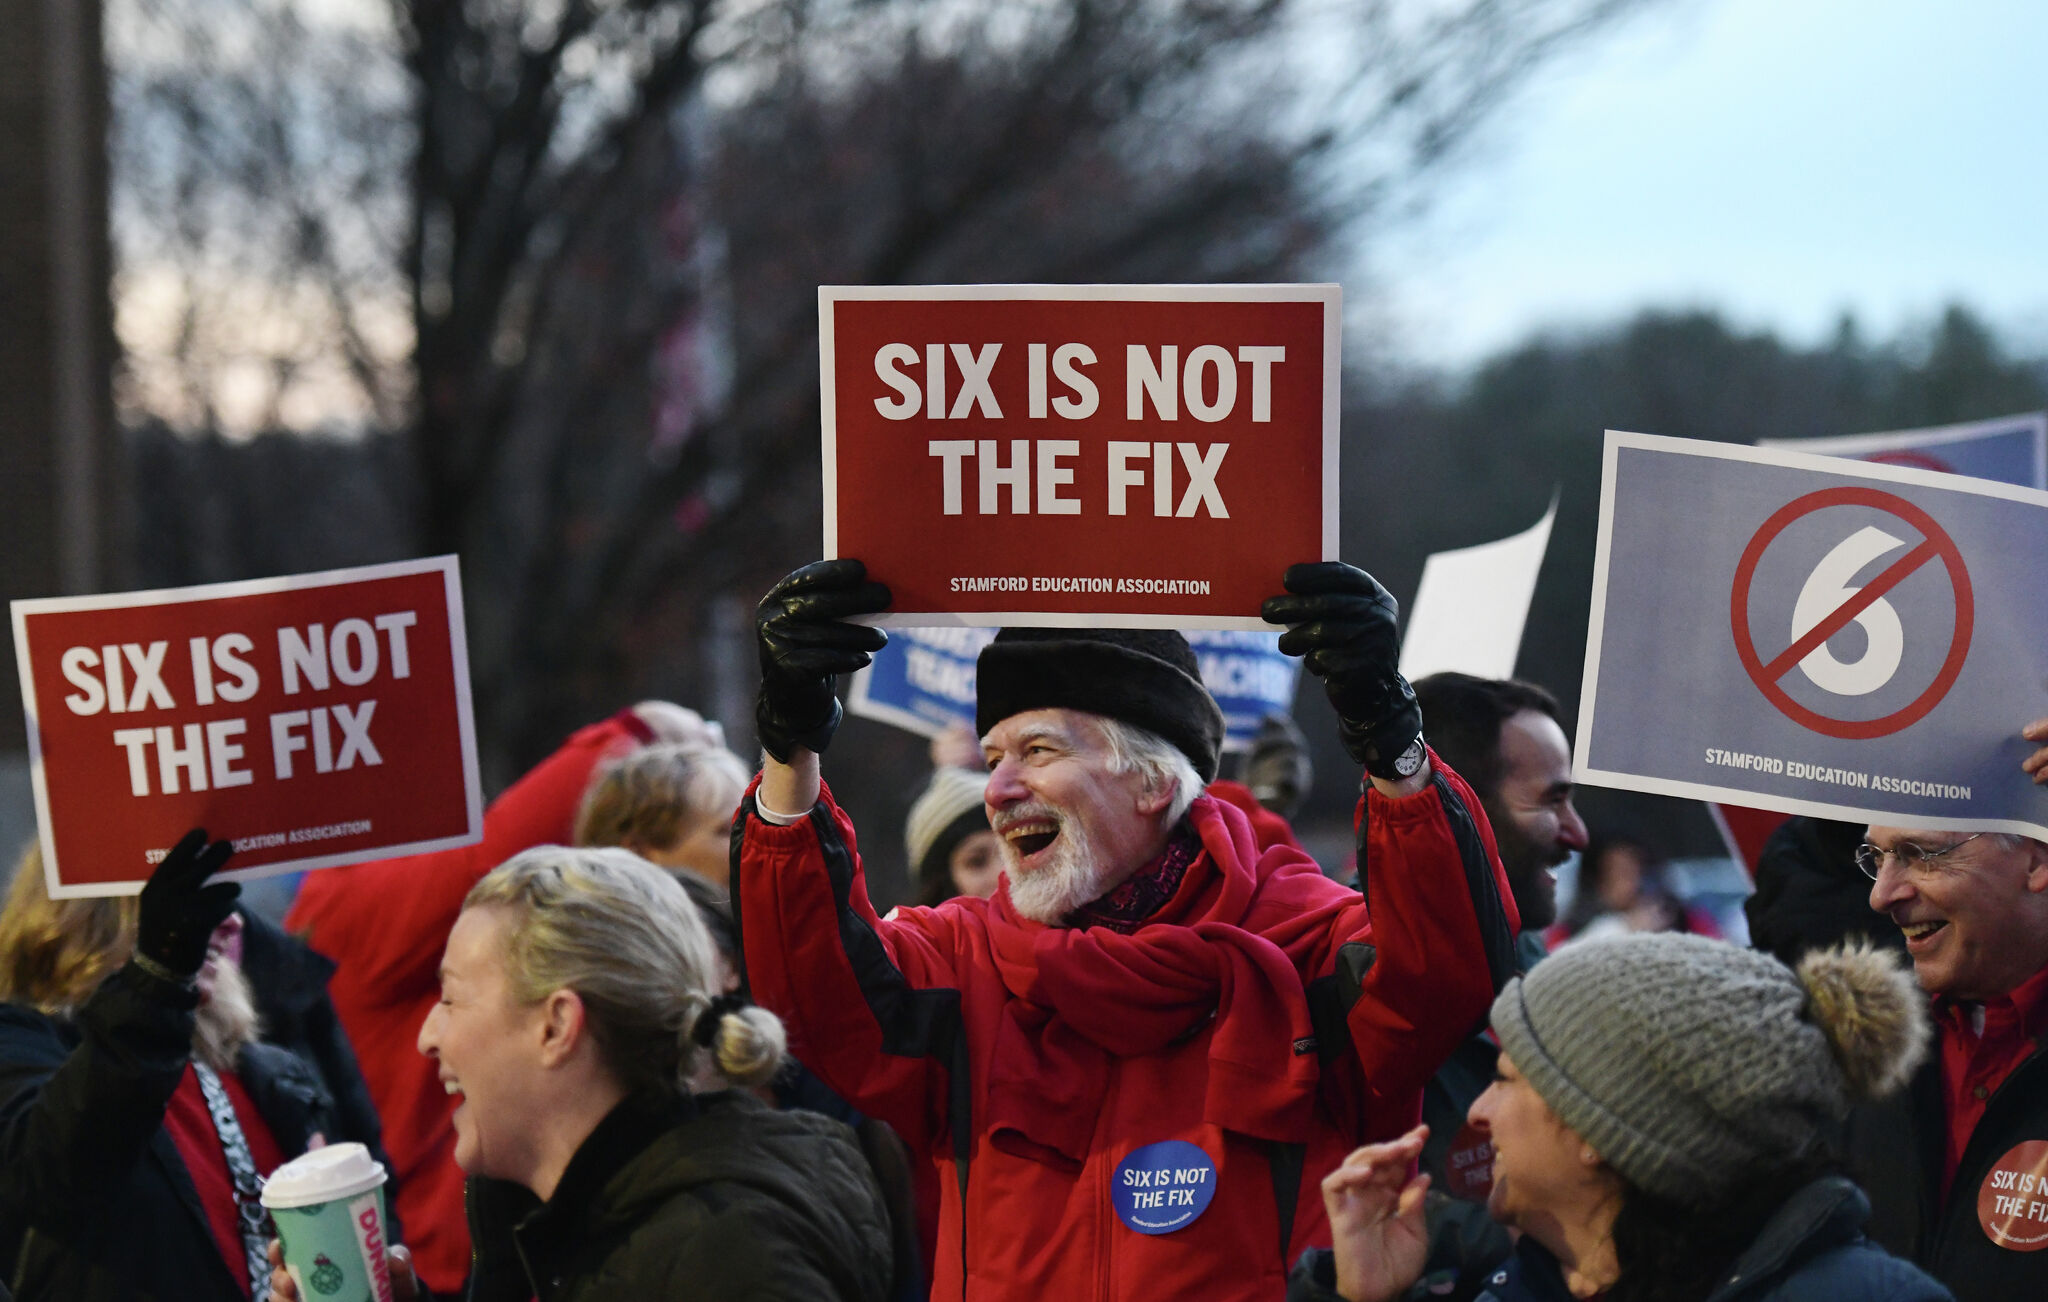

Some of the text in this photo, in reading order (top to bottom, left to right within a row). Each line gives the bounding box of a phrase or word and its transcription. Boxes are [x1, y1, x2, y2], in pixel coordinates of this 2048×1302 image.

[873, 343, 1286, 422] SIX IS NOT
[928, 440, 1231, 518] THE FIX
[950, 577, 1210, 595] STAMFORD EDUCATION ASSOCIATION
[1791, 525, 1906, 696] 6
[60, 611, 417, 716] SIX IS NOT
[114, 700, 383, 797] THE FIX
[1705, 747, 1972, 800] STAMFORD EDUCATION ASSOCIATION
[231, 819, 372, 854] UCATION ASSOCIATION
[1123, 1167, 1210, 1187] SIX IS NOT
[1132, 1189, 1196, 1209] THE FIX
[1990, 1170, 2018, 1190] SIX
[2018, 1173, 2036, 1193] IS
[1995, 1195, 2027, 1218] THE
